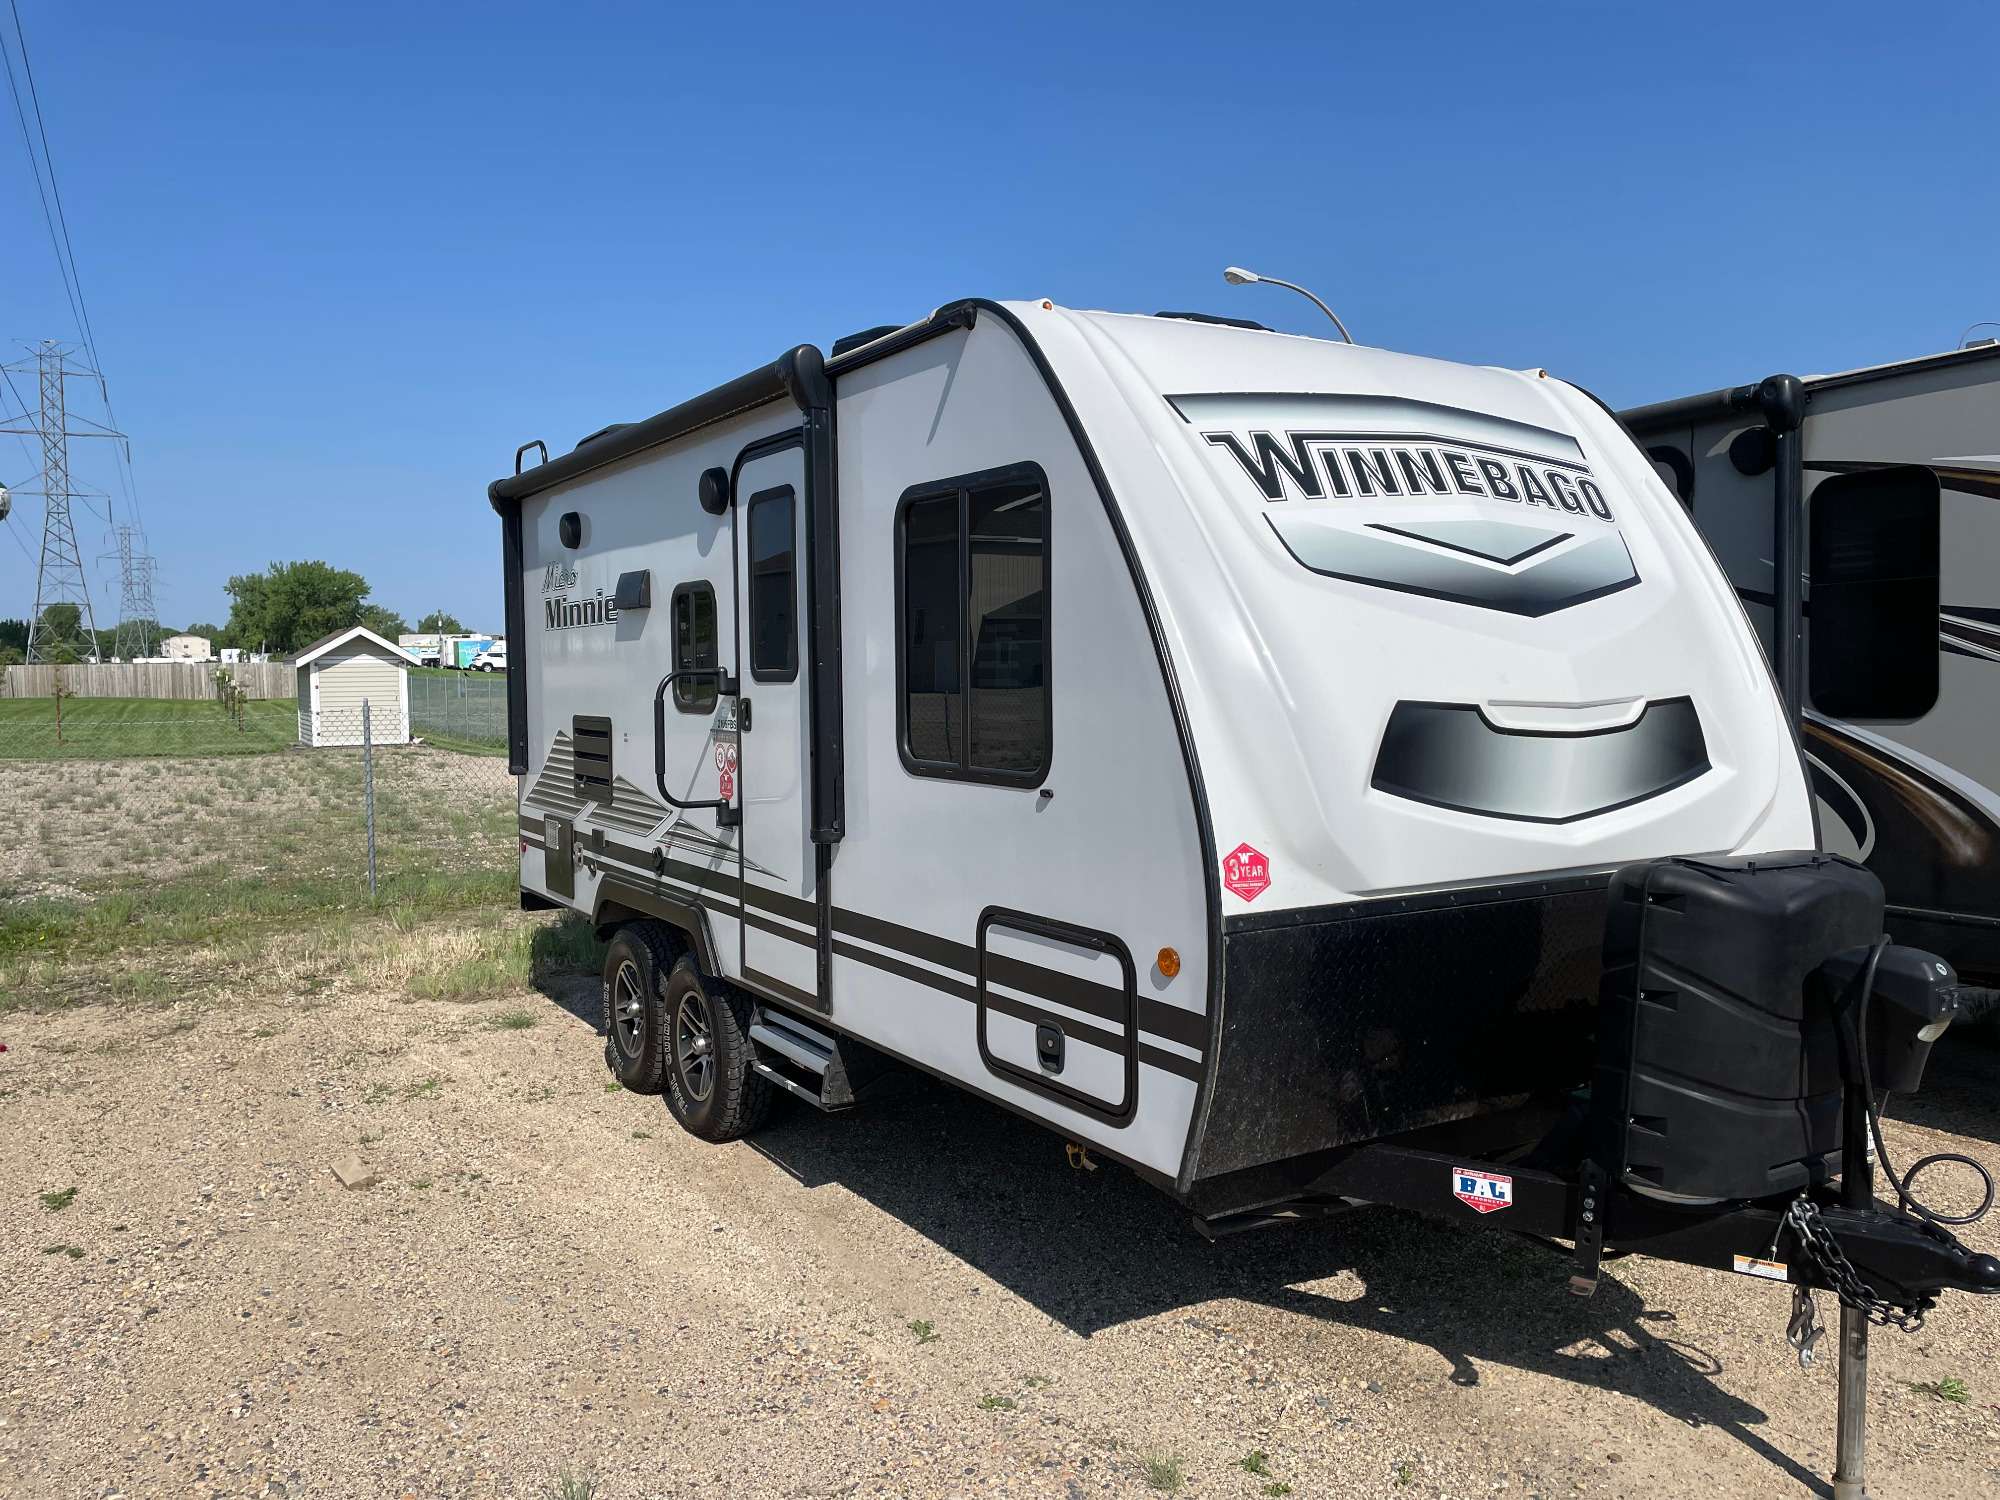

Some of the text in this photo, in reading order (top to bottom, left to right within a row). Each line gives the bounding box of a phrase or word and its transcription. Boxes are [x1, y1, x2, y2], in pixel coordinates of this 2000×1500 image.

[1200, 430, 1616, 523] WINNEBAGO
[544, 588, 619, 631] Minnie
[1229, 858, 1264, 880] 3 YEAR
[1459, 1177, 1506, 1200] BAL
